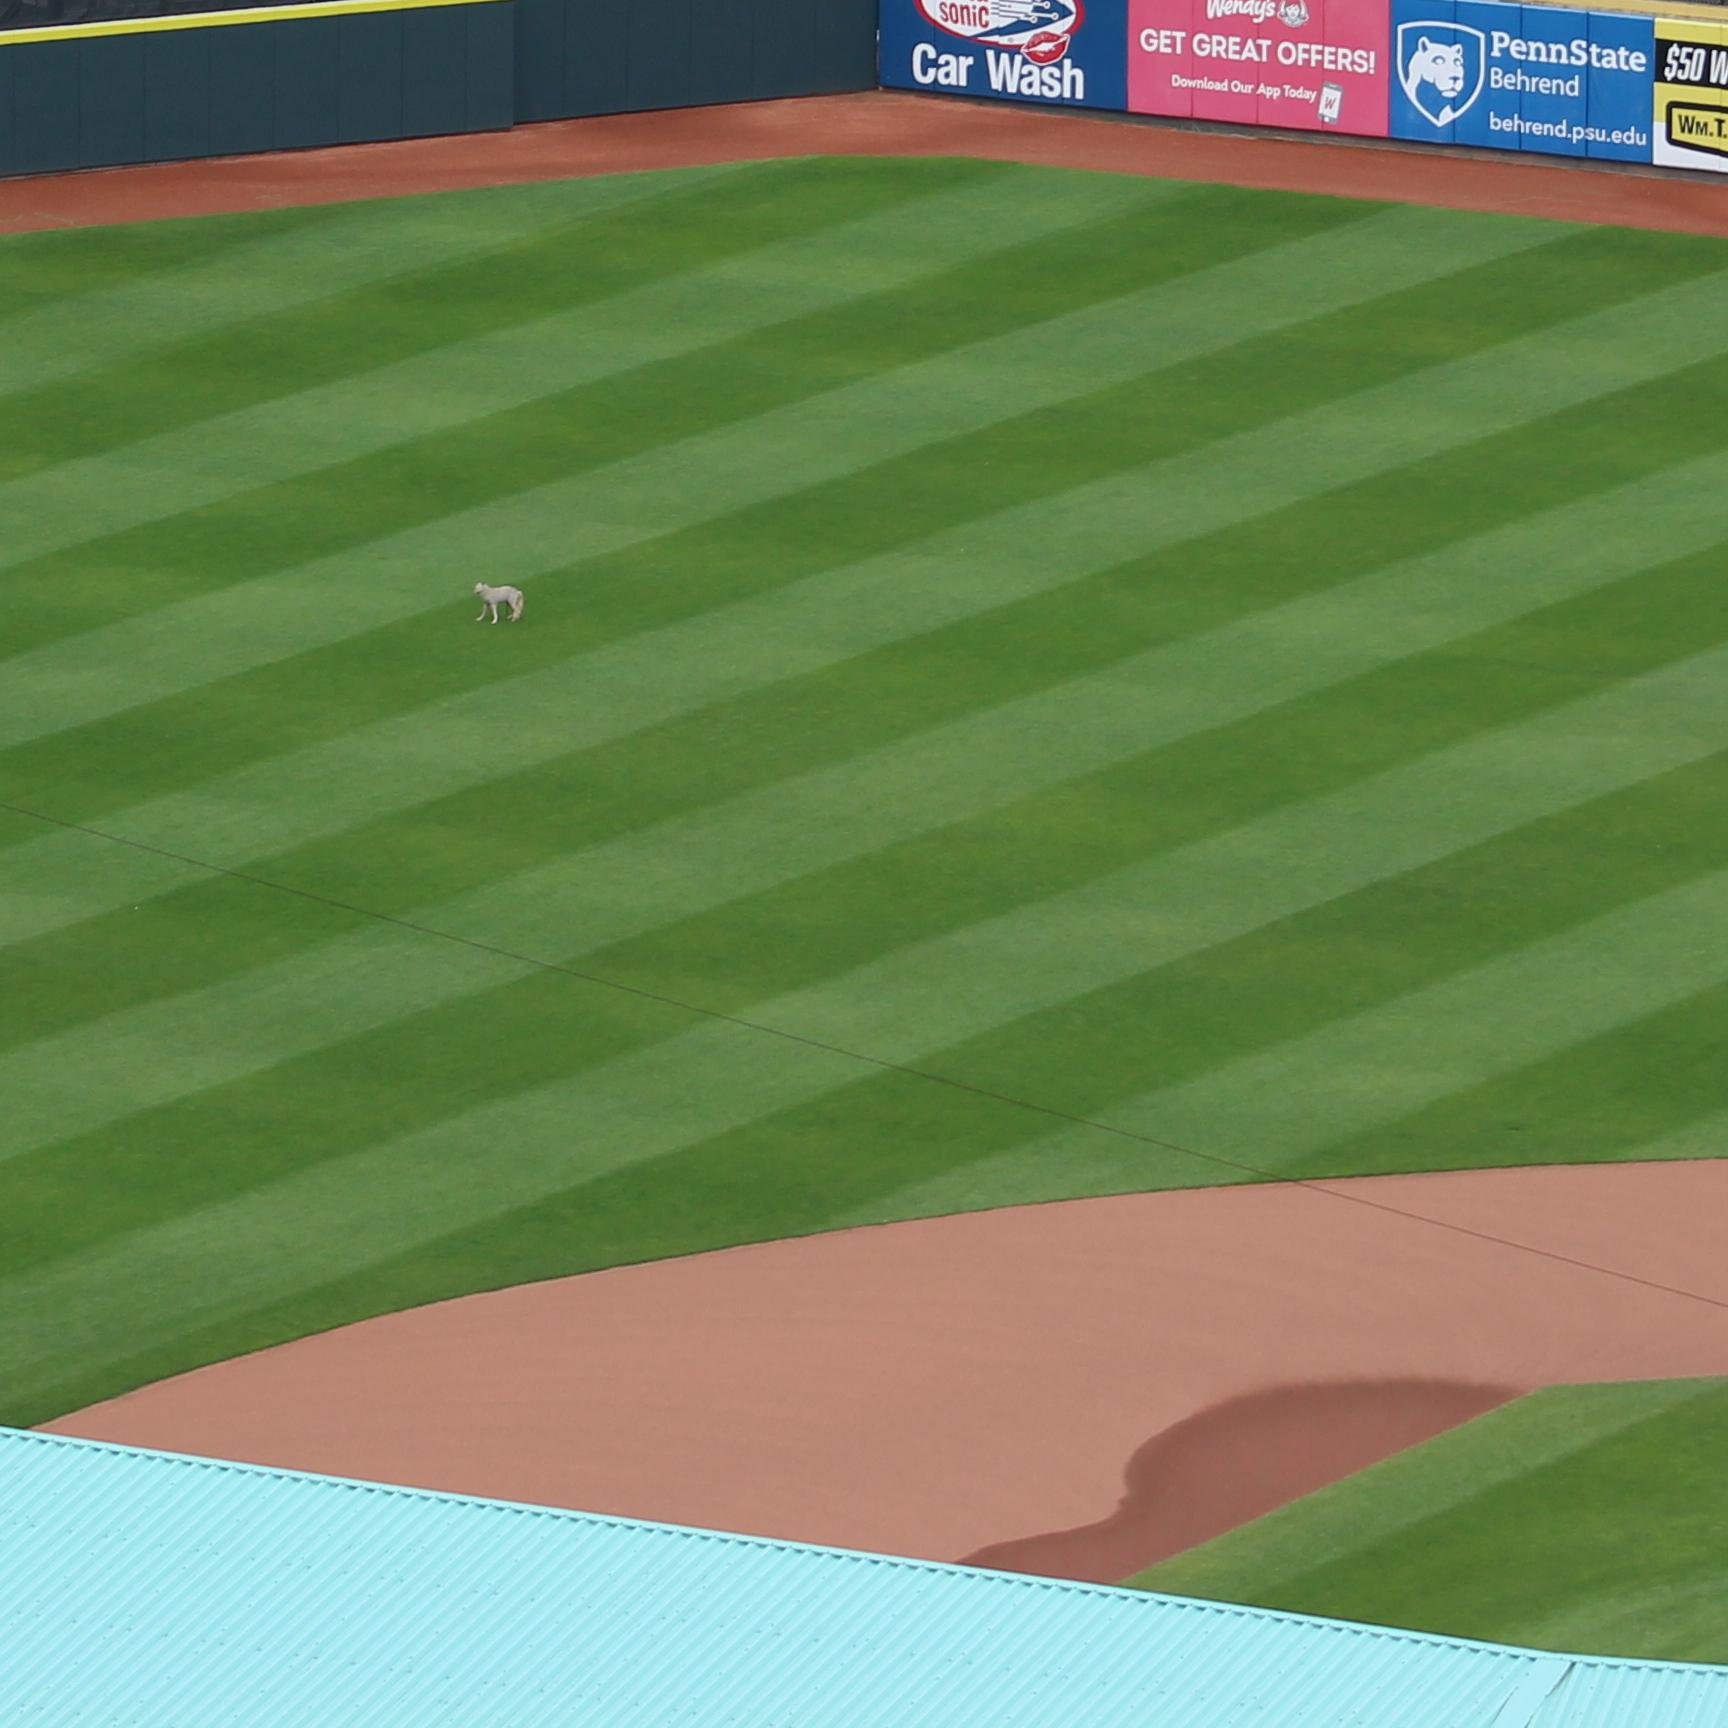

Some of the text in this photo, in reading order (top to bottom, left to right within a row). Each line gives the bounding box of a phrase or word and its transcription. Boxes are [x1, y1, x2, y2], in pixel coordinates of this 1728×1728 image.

[939, 1, 990, 28] sonic
[1140, 28, 1376, 75] GET GREAT OFFERS!
[1664, 43, 1706, 81] $50
[912, 43, 1085, 100] Car Wash
[1490, 67, 1580, 97] Behrend
[1171, 75, 1317, 103] Download Our App Today
[1489, 112, 1648, 146] behrend.psu.edu
